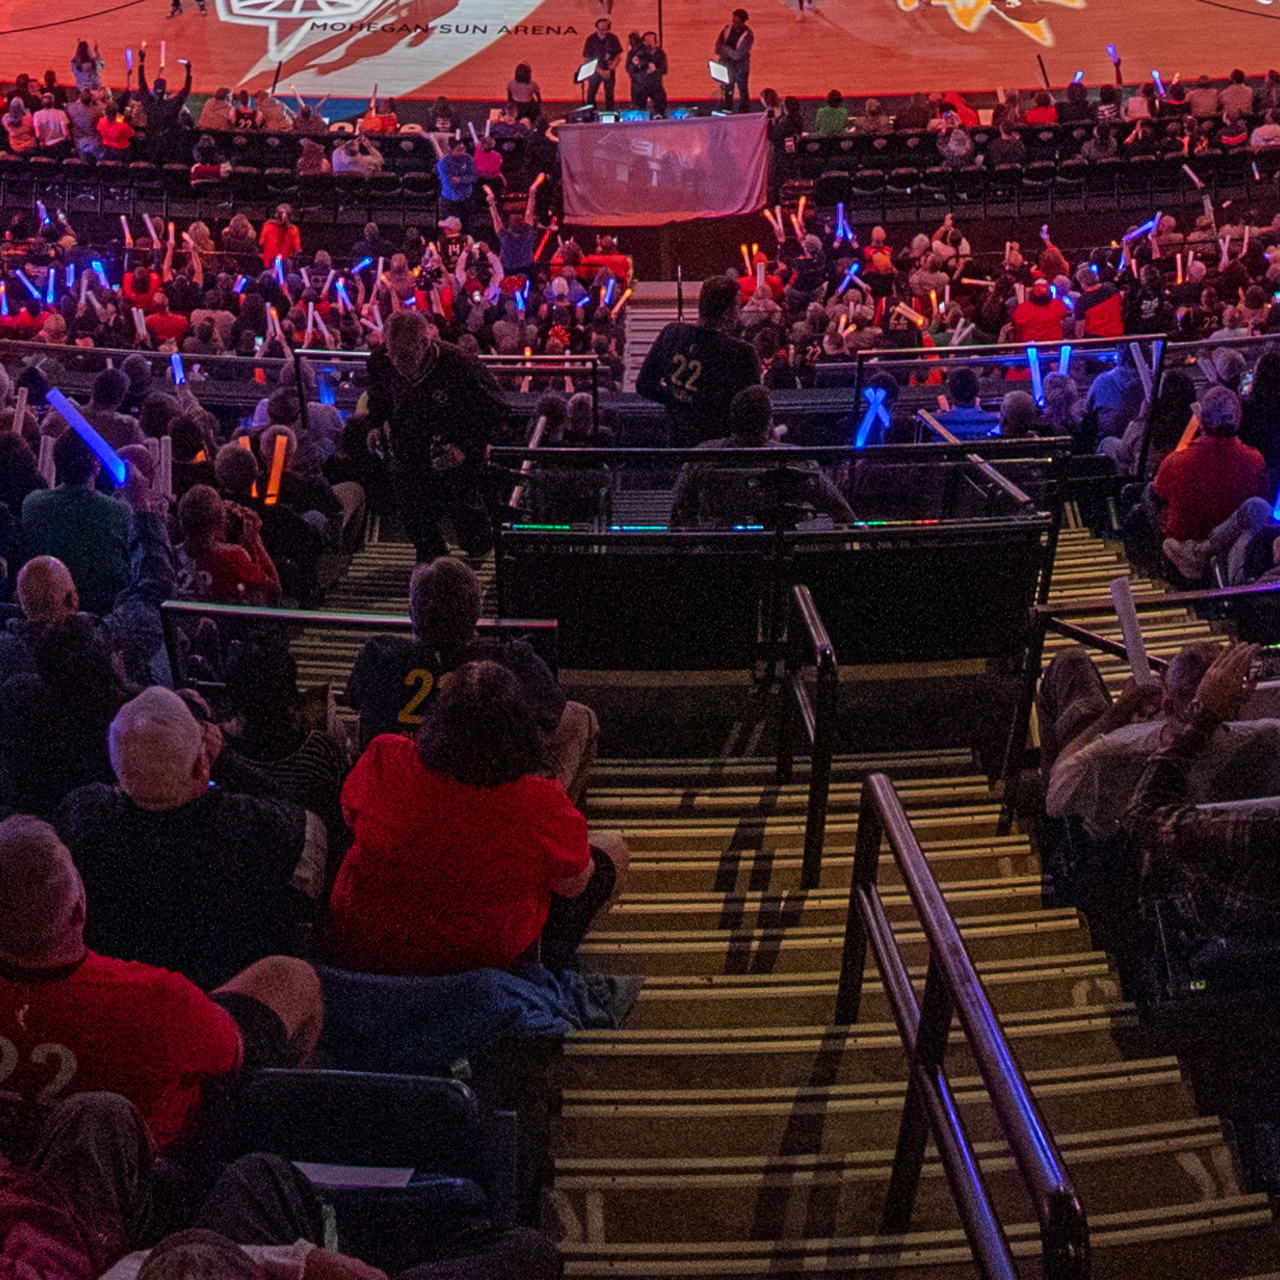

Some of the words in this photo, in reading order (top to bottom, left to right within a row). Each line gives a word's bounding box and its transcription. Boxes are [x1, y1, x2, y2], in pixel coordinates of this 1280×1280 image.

[309, 20, 431, 35] MOHEGAN
[439, 22, 488, 35] SUN
[497, 23, 579, 36] ARENA
[448, 243, 460, 256] 14
[671, 353, 702, 392] 22
[396, 668, 434, 725] 2
